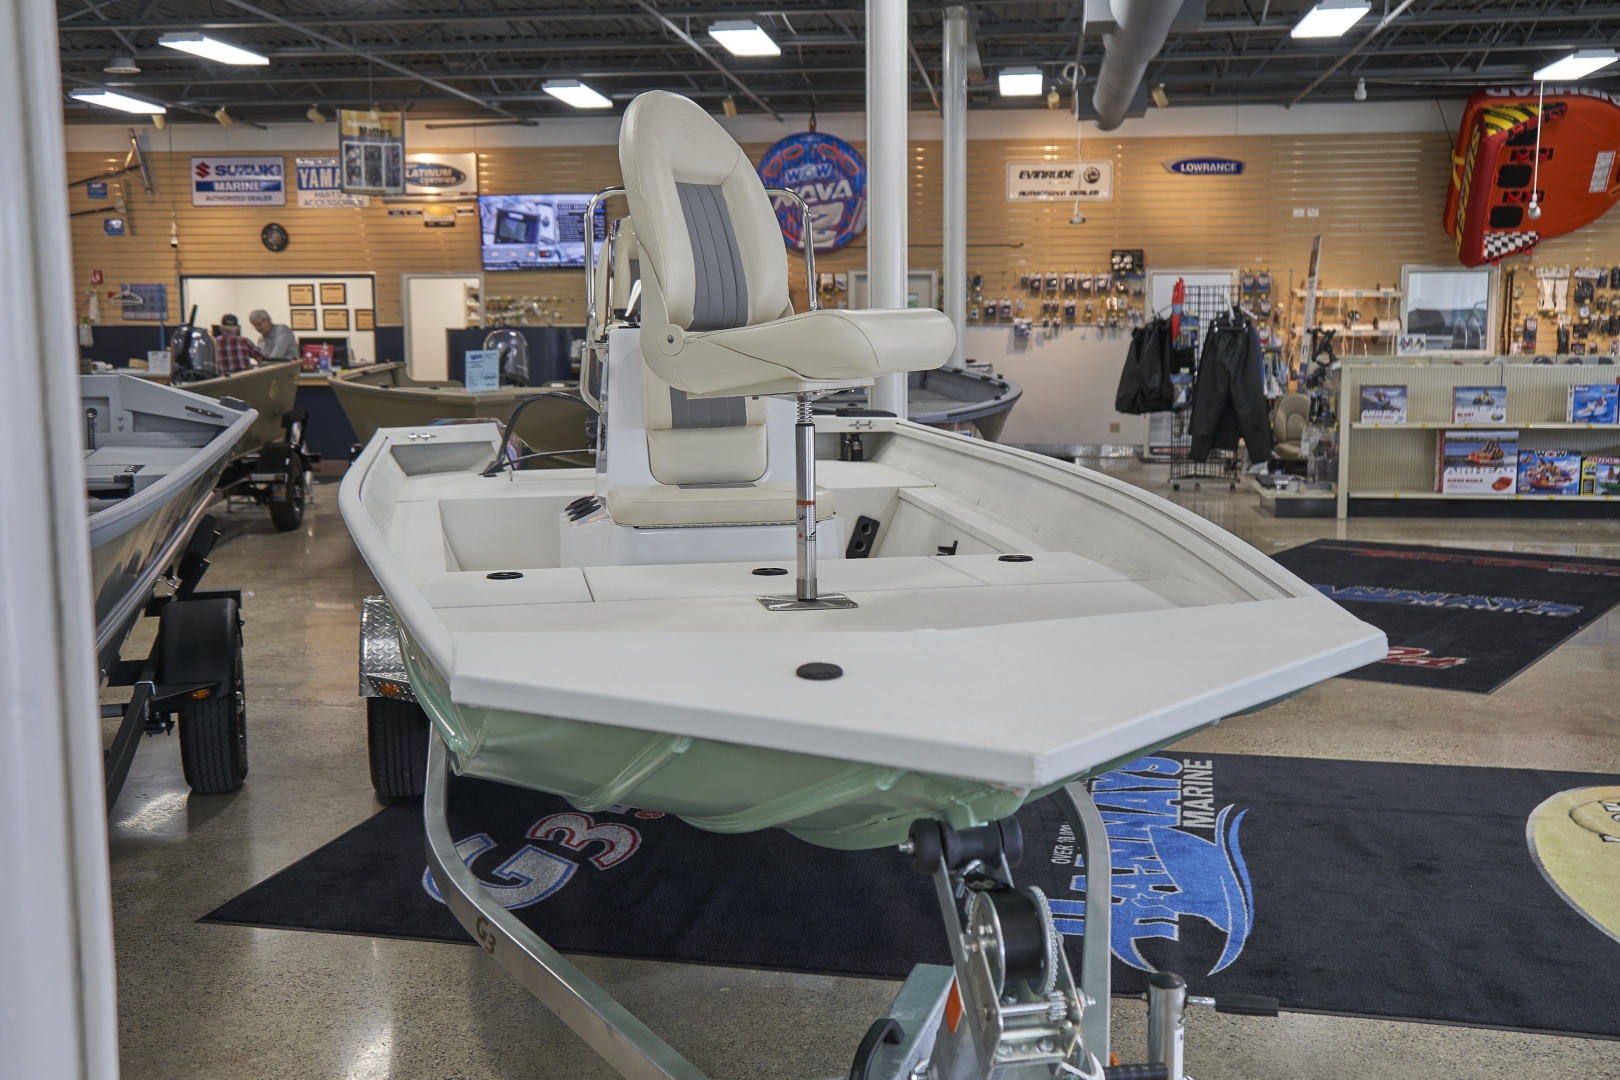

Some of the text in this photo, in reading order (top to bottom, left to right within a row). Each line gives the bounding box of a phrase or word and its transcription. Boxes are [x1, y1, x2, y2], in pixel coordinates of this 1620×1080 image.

[215, 163, 282, 176] SUZUKI
[405, 169, 453, 178] LATINUM
[785, 163, 832, 184] WOW
[1180, 162, 1238, 172] LOWRANCE
[299, 168, 341, 189] YAMA
[1019, 169, 1075, 179] EVINRUDE
[215, 181, 261, 191] MARINE
[1535, 450, 1568, 458] WOW
[1444, 466, 1517, 475] AIRHEAD
[1182, 758, 1215, 829] MARINE
[422, 812, 642, 910] G3
[1051, 844, 1073, 865] OVER
[476, 916, 497, 954] G3
